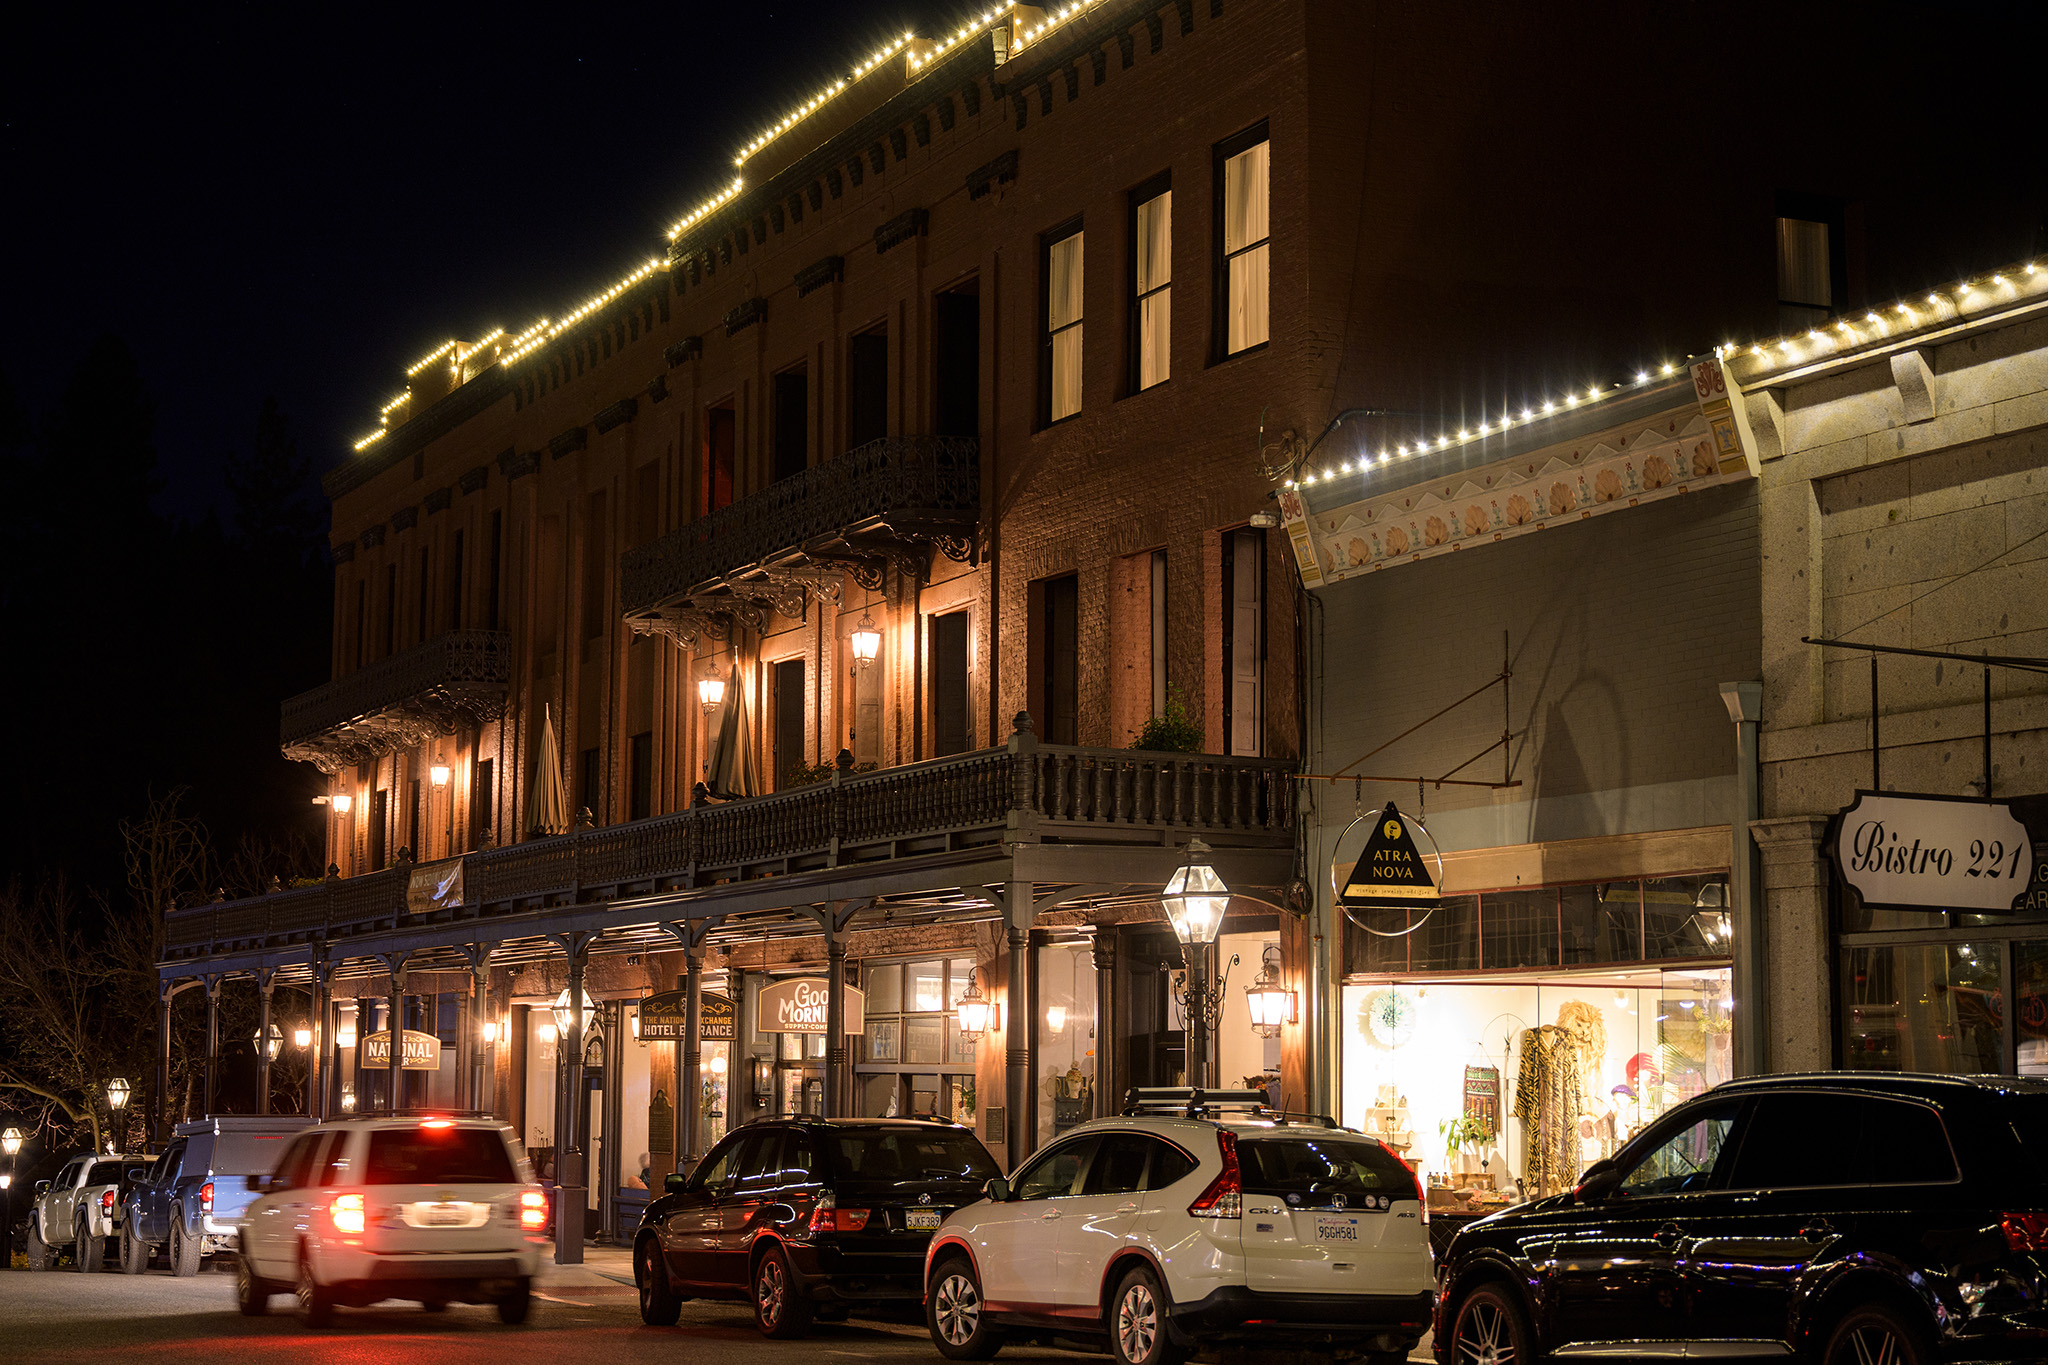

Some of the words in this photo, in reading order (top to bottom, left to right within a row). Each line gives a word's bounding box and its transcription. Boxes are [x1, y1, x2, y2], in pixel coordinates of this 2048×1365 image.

[1373, 849, 1412, 862] ATRA
[1851, 820, 1958, 877] Bistro
[1964, 839, 2024, 879] 221
[1372, 866, 1414, 879] NOVA
[794, 982, 829, 1008] GOO
[778, 997, 829, 1024] MORNI
[644, 1016, 658, 1025] THE
[700, 1016, 732, 1025] XCHANGE
[644, 1024, 676, 1036] HOTEL
[679, 1024, 733, 1036] ERANCE
[1318, 1225, 1358, 1240] 9GGH581
